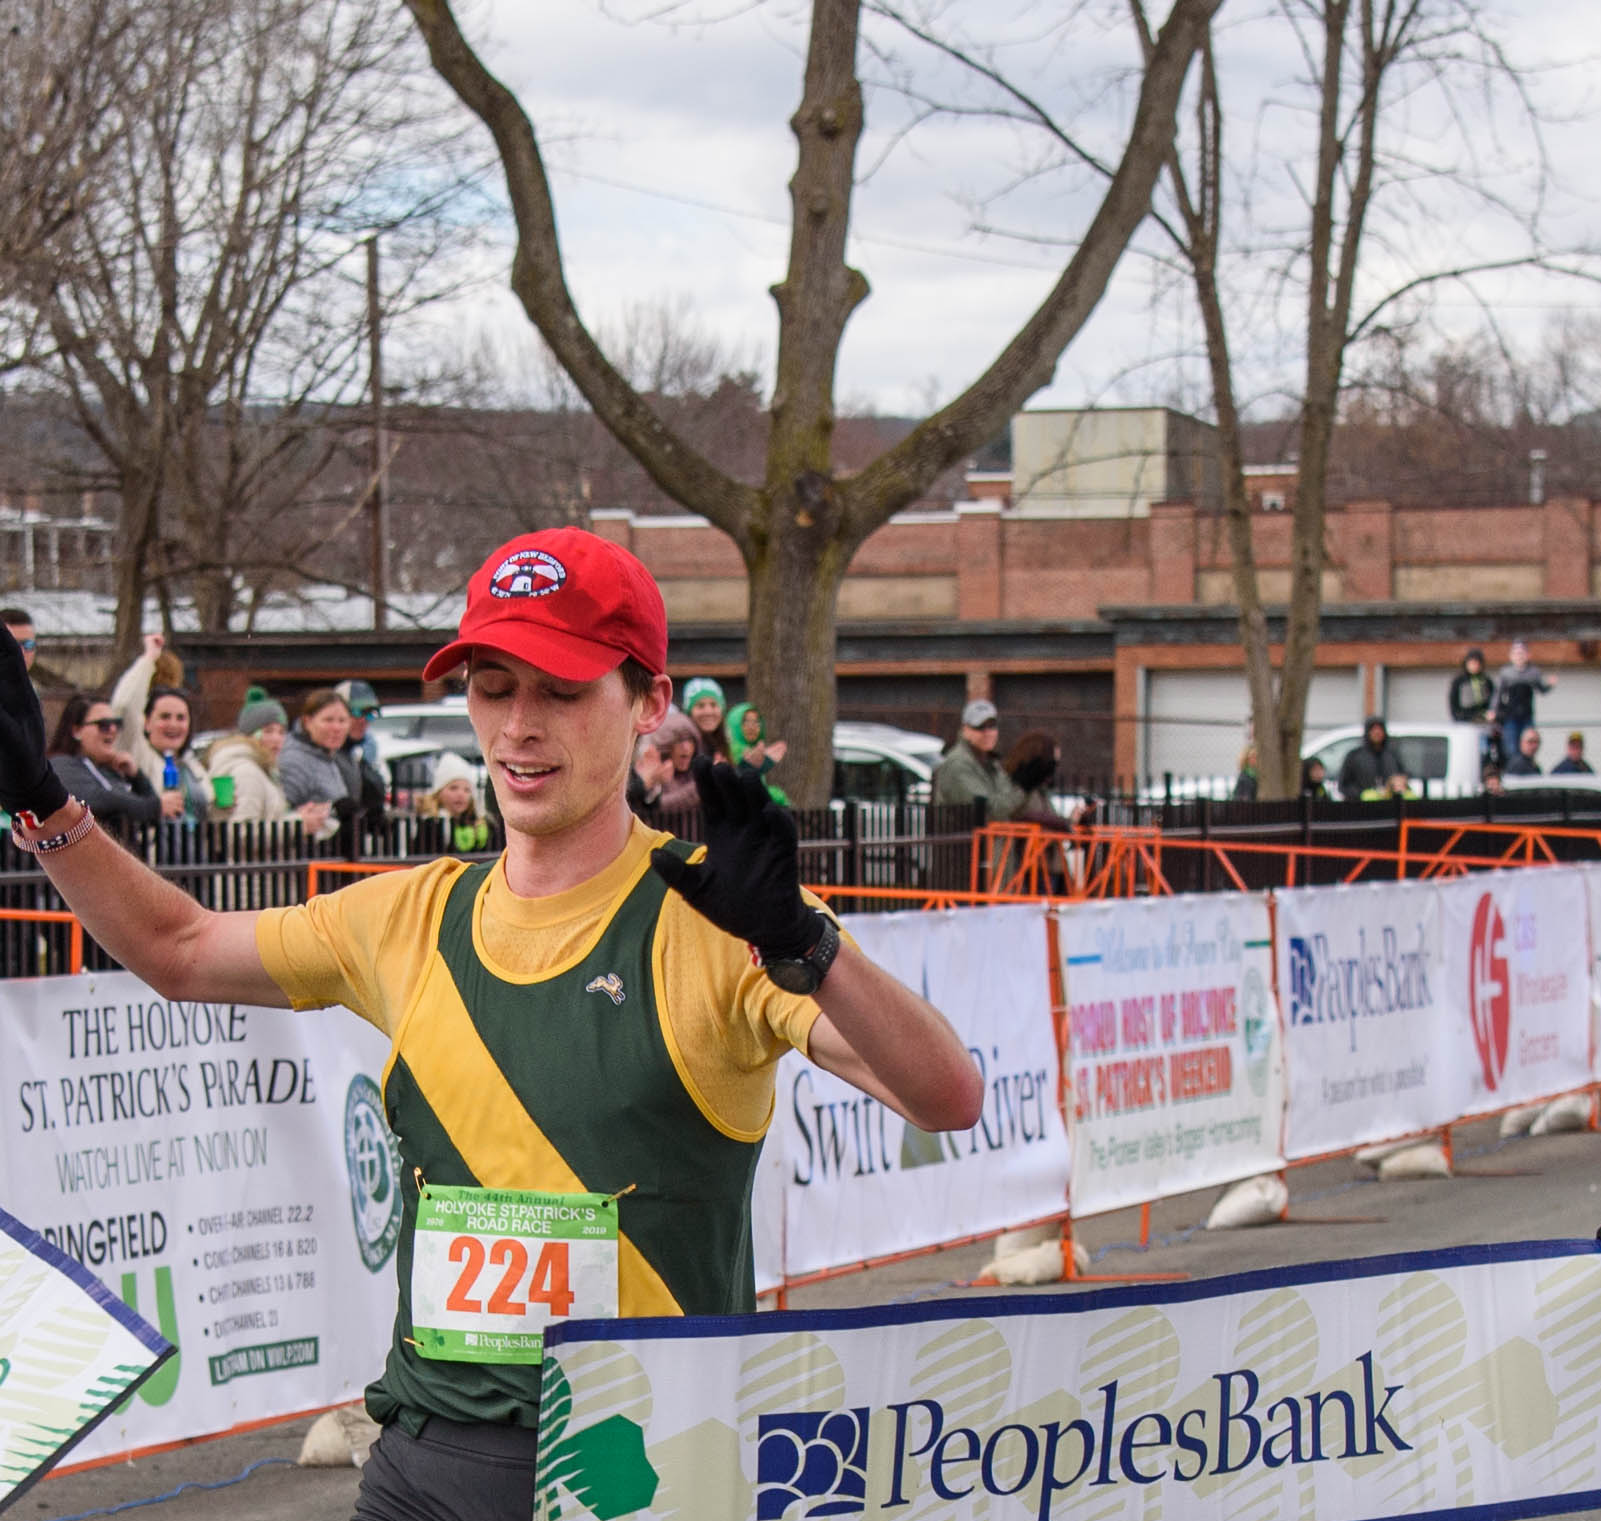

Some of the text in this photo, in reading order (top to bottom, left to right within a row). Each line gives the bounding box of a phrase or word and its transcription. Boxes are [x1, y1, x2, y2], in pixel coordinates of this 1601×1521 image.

[62, 1000, 248, 1059] THE HOLYOKE
[19, 1080, 56, 1133] ST.
[60, 1062, 192, 1128] PATRICK'S
[56, 1145, 119, 1195] WATCH
[124, 1140, 163, 1185] LIVE
[167, 1136, 187, 1179] AT
[241, 1127, 268, 1167] ON
[287, 1204, 315, 1224] 22.2
[434, 1200, 497, 1218] HOLYOKE
[458, 1190, 566, 1206] The 44th Annual
[466, 1216, 552, 1235] ROAD RACE
[446, 1235, 575, 1316] 224
